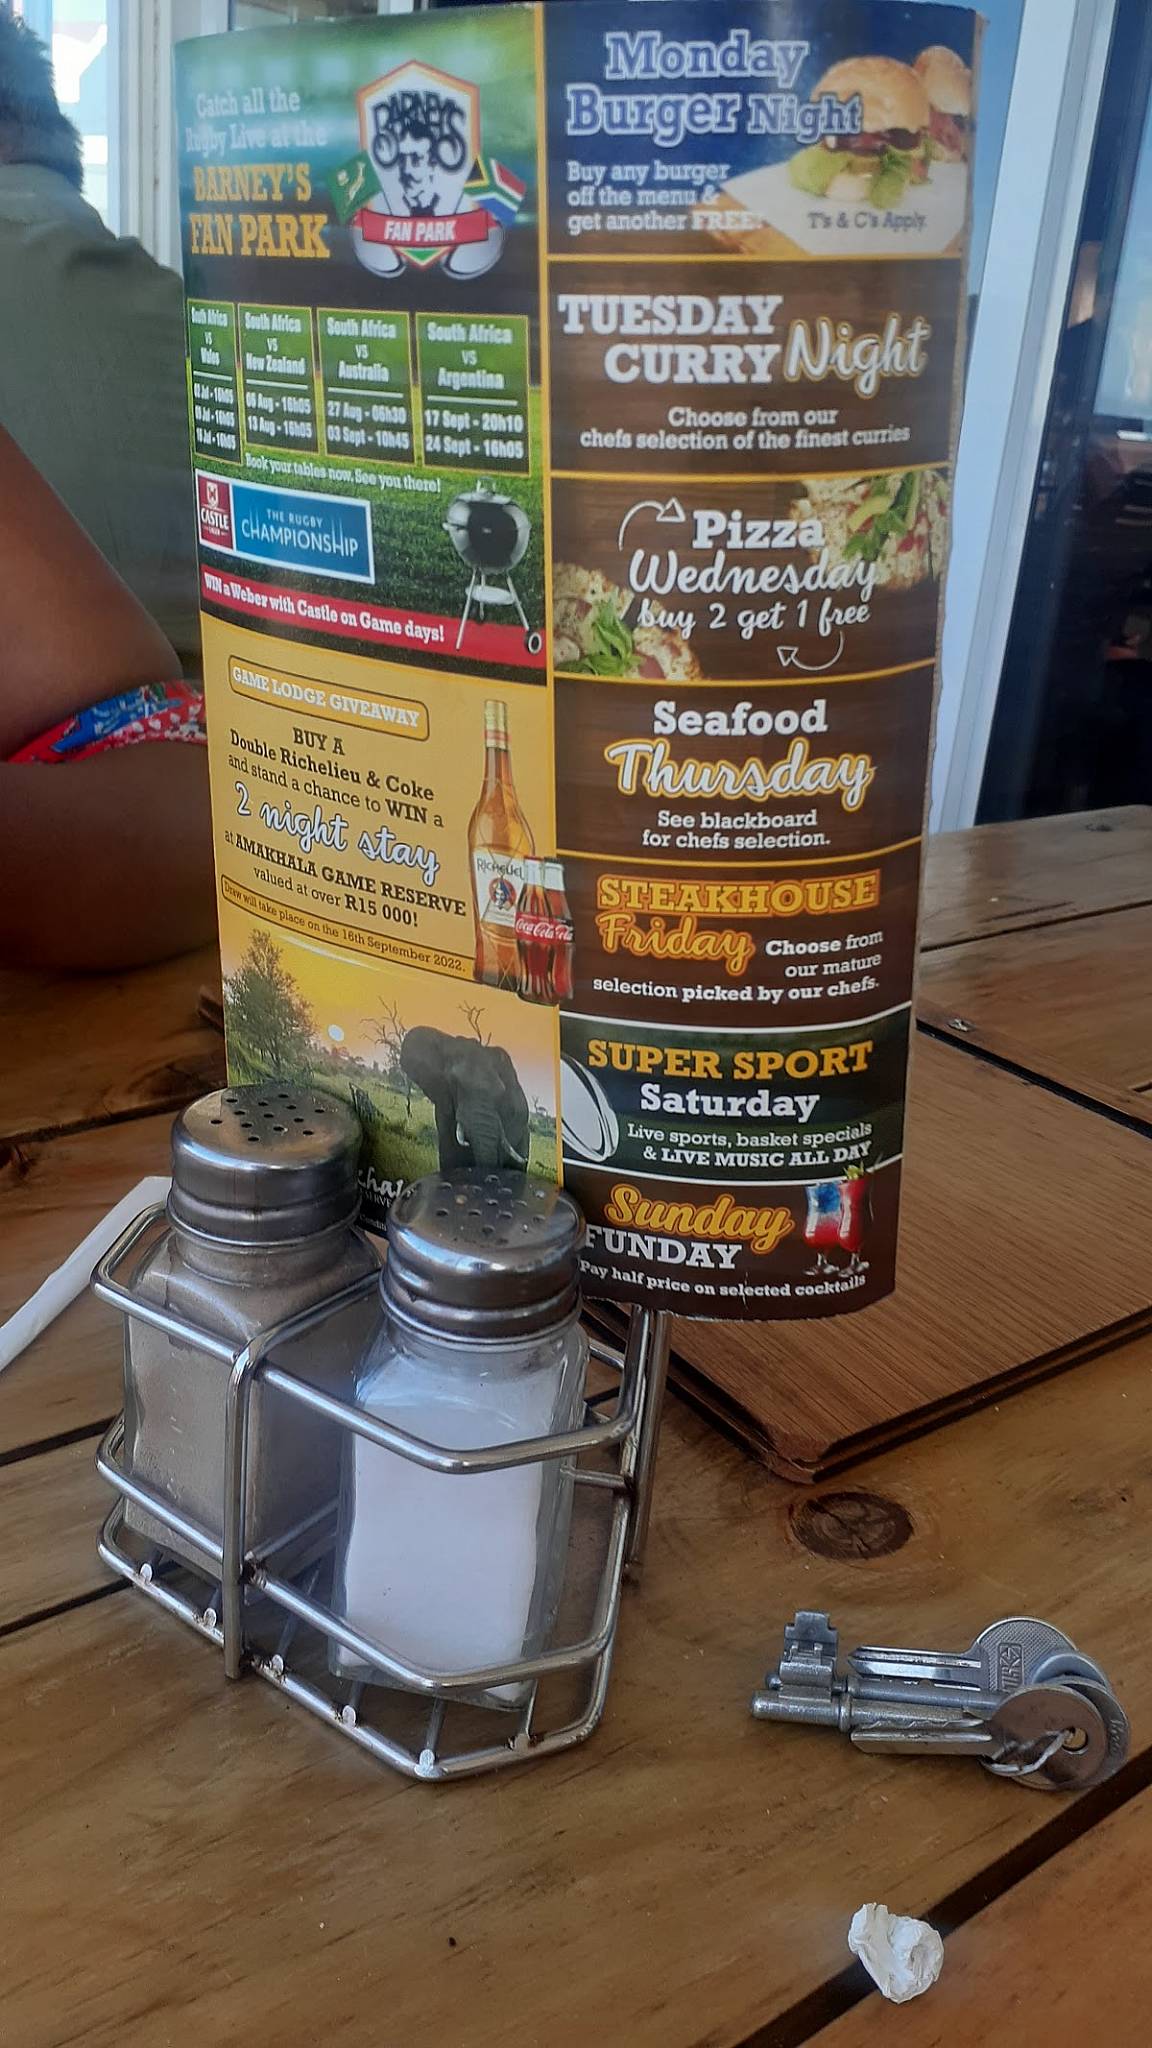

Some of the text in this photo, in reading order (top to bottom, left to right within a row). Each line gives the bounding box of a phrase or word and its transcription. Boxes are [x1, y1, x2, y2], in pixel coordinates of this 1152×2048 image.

[605, 28, 809, 88] Monday
[197, 86, 299, 118] Catch all the
[566, 83, 863, 147] Burger Night
[232, 123, 265, 148] Live
[271, 125, 294, 147] at
[298, 121, 327, 146] the
[193, 163, 311, 200] BARNEY'S
[568, 160, 730, 185] Buy any burger
[568, 185, 720, 207] off the menu &
[189, 214, 330, 258] FAN PARK
[384, 220, 455, 240] FAN PARK
[568, 213, 601, 236] get
[605, 210, 686, 232] another
[836, 213, 848, 229] &
[327, 317, 396, 339] South Africa
[428, 322, 512, 344] South Africa
[557, 295, 783, 335] TUESDAY
[339, 361, 389, 383] Australia
[605, 344, 782, 383] CURRY
[783, 313, 931, 399] Night
[438, 370, 504, 391] Argentina
[668, 407, 838, 426] Choose from our
[580, 426, 911, 450] chefs selection of the finest curries
[246, 452, 441, 492] Book your tables now. See you there!
[201, 508, 228, 530] CASTLE
[241, 514, 358, 556] CHAMPIONSHIP
[267, 509, 323, 526] THE RUGBY
[692, 509, 825, 548] Pizza
[629, 549, 877, 602] Wednesday
[204, 572, 444, 644] WIN a Weber with Castle on Game days!
[637, 596, 870, 640] buy 2 get 1 free
[232, 666, 419, 728] GAME LODGE GIVEAWAY
[653, 699, 828, 736] Seafood
[293, 728, 345, 755] BUY A
[230, 728, 434, 801] Double Richelieu & Coke
[604, 737, 877, 811] Thursday
[229, 754, 444, 828] and stand a chance to WIN a
[234, 782, 440, 886] 2 night stay
[658, 810, 817, 829] See blackboard
[642, 829, 830, 850] for chefs selection.
[224, 829, 466, 916] at AMAKHALA GAME RESERVE
[254, 866, 418, 927] valued at over R15 000!
[597, 869, 880, 918] STEAKHOUSE
[224, 881, 466, 972] Draw will take place on the 16th September 2022.
[595, 910, 755, 976] Friday
[765, 932, 883, 956] Choose from
[785, 954, 881, 978] our mature
[593, 975, 880, 1004] selection picked by our chefs.
[588, 1039, 873, 1080] SUPER SPORT
[640, 1083, 820, 1123] Saturday
[627, 1122, 872, 1149] Live sports, basket specials
[643, 1141, 871, 1167] & LIVE MUSIC ALL DAY
[605, 1183, 795, 1255] Sunday
[586, 1224, 742, 1270] FUNDAY
[580, 1259, 866, 1298] Pay half price on selected cocktails
